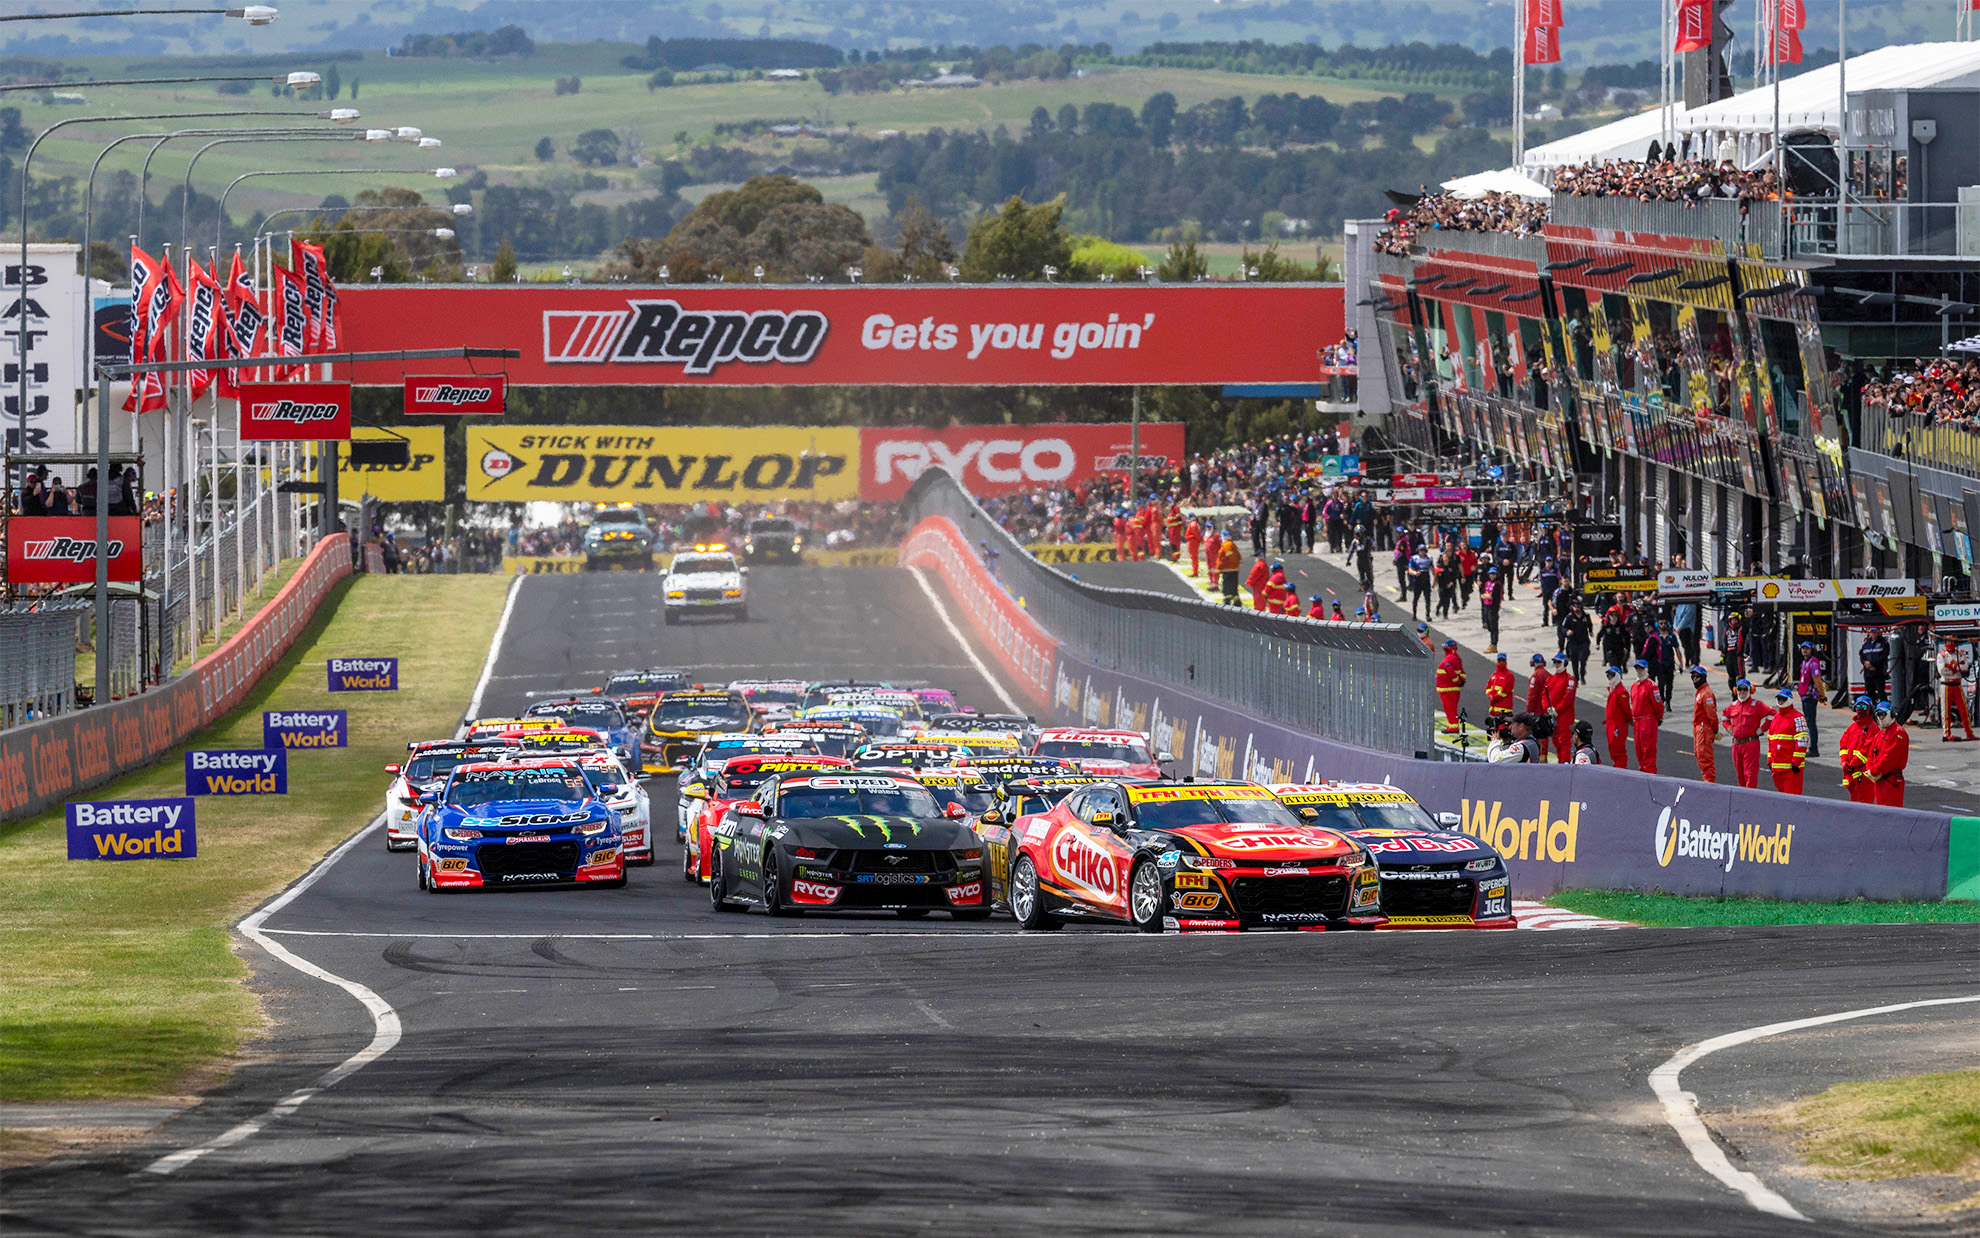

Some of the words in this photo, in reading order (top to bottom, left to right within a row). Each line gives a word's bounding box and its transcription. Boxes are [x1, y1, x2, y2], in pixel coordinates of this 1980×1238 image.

[607, 299, 829, 374] Repco
[861, 314, 958, 350] Gets
[967, 323, 1041, 360] you
[436, 384, 492, 405] Repco
[274, 400, 339, 424] Repco
[519, 435, 588, 449] STICK
[595, 435, 655, 449] WITH
[527, 453, 846, 490] DUNLOP
[52, 537, 124, 563] Repo
[1868, 585, 1906, 598] Repco
[1937, 609, 1970, 617] OPTUS
[332, 659, 391, 674] Battery
[342, 674, 390, 688] World
[269, 712, 338, 730] Battery
[941, 720, 1020, 728] Kubota
[280, 731, 339, 748] World
[1052, 733, 1132, 744] Liberty
[859, 750, 968, 760] OPTUS
[31, 729, 72, 798] Coates
[193, 752, 277, 773] Battery
[979, 765, 1052, 774] eadfast
[207, 773, 276, 793] World
[922, 777, 986, 786] STORGE
[1138, 790, 1176, 799] TFH
[1229, 789, 1263, 797] TFH
[1276, 786, 1400, 794] AMOL
[1284, 795, 1344, 804] ATIONAL
[75, 803, 183, 829] Battery
[1461, 799, 1579, 862] World
[93, 829, 182, 856] World
[622, 834, 643, 842] SUZU
[1221, 836, 1329, 849] CHIKO
[1408, 838, 1480, 852] Bull
[437, 843, 468, 851] Tyrepower
[796, 847, 815, 858] dba
[1056, 832, 1114, 896] CHIKO
[1201, 858, 1233, 868] PEDDERS
[807, 870, 833, 878] MONSTER
[1177, 875, 1203, 886] TFH
[794, 881, 838, 898] RYCO
[948, 883, 980, 899] RYCO
[1490, 889, 1504, 897] AUTO
